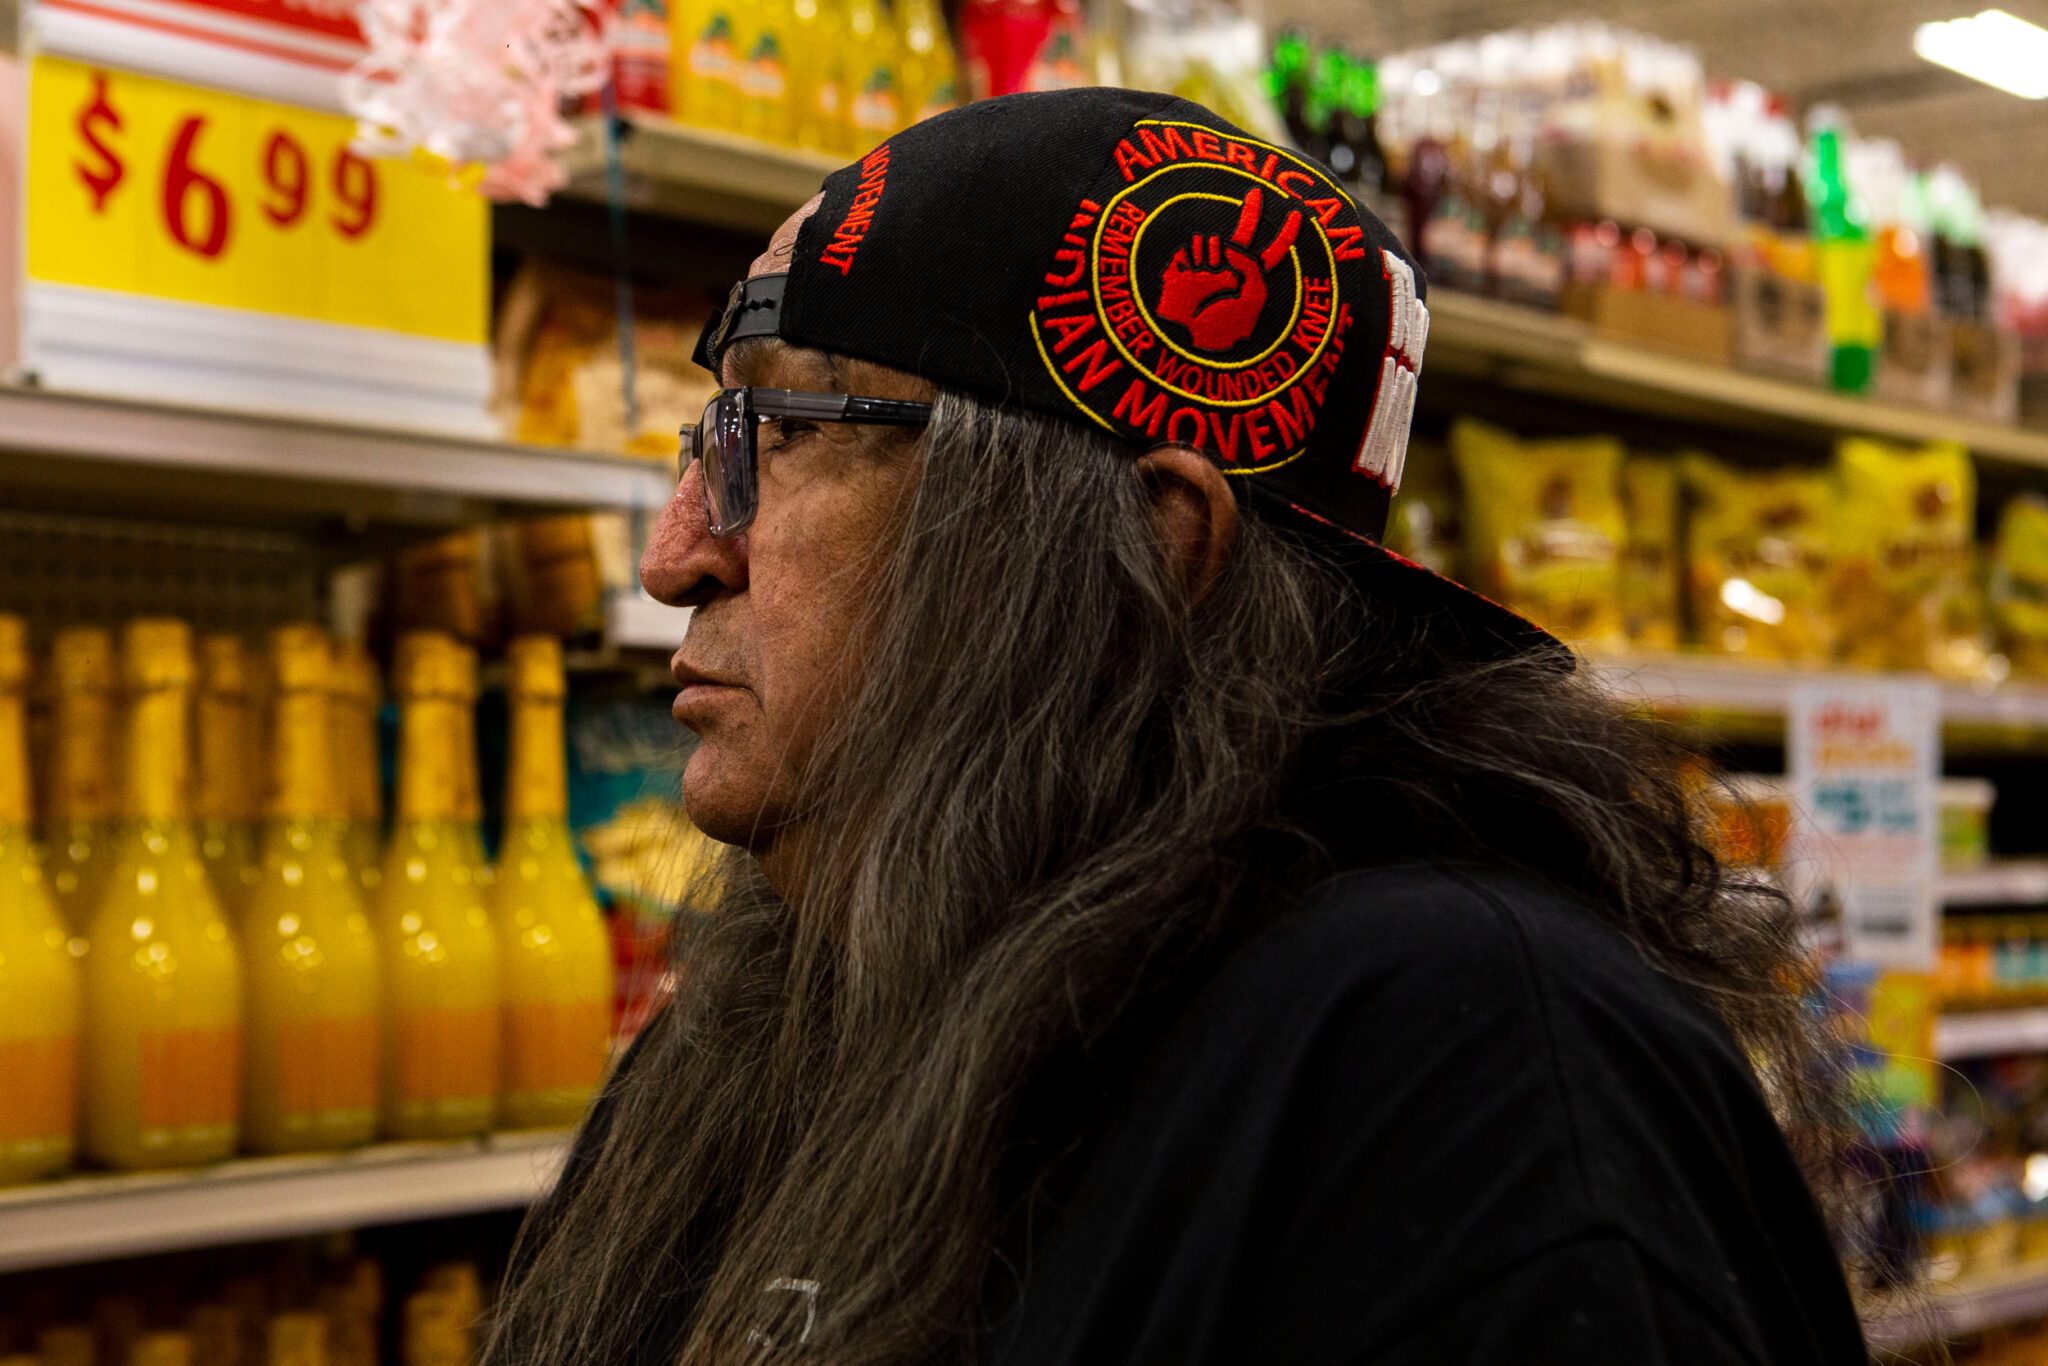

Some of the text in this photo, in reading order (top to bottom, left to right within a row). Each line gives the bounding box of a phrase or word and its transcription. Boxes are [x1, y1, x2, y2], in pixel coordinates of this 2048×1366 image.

[820, 143, 892, 277] MOVEMENT
[1112, 126, 1366, 263] AMERICAN
[1037, 198, 1354, 463] INDIAN MOVEMENT
[1099, 200, 1332, 402] REMEMBER WOUNDED KNEE
